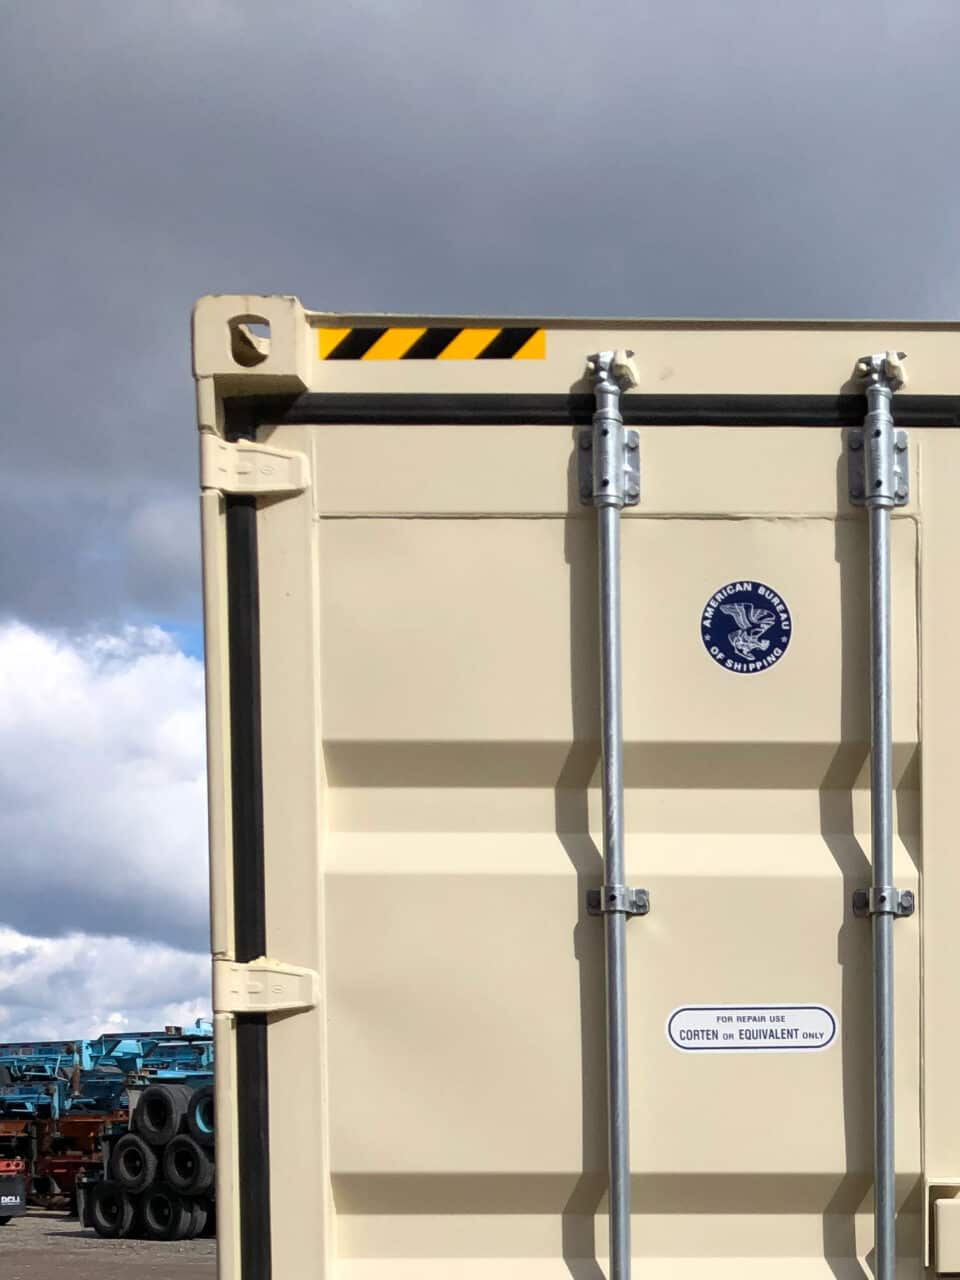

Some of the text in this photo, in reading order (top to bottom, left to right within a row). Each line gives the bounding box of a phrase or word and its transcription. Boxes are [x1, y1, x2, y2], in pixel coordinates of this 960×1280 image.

[702, 582, 790, 630] AMERICAN BUREAU
[710, 646, 783, 672] OF SHIPPING
[716, 1015, 786, 1023] FOR REPAIR USE
[679, 1029, 719, 1041] CORTEN
[738, 1028, 799, 1040] EQUIVALENT
[802, 1032, 824, 1040] ONLY
